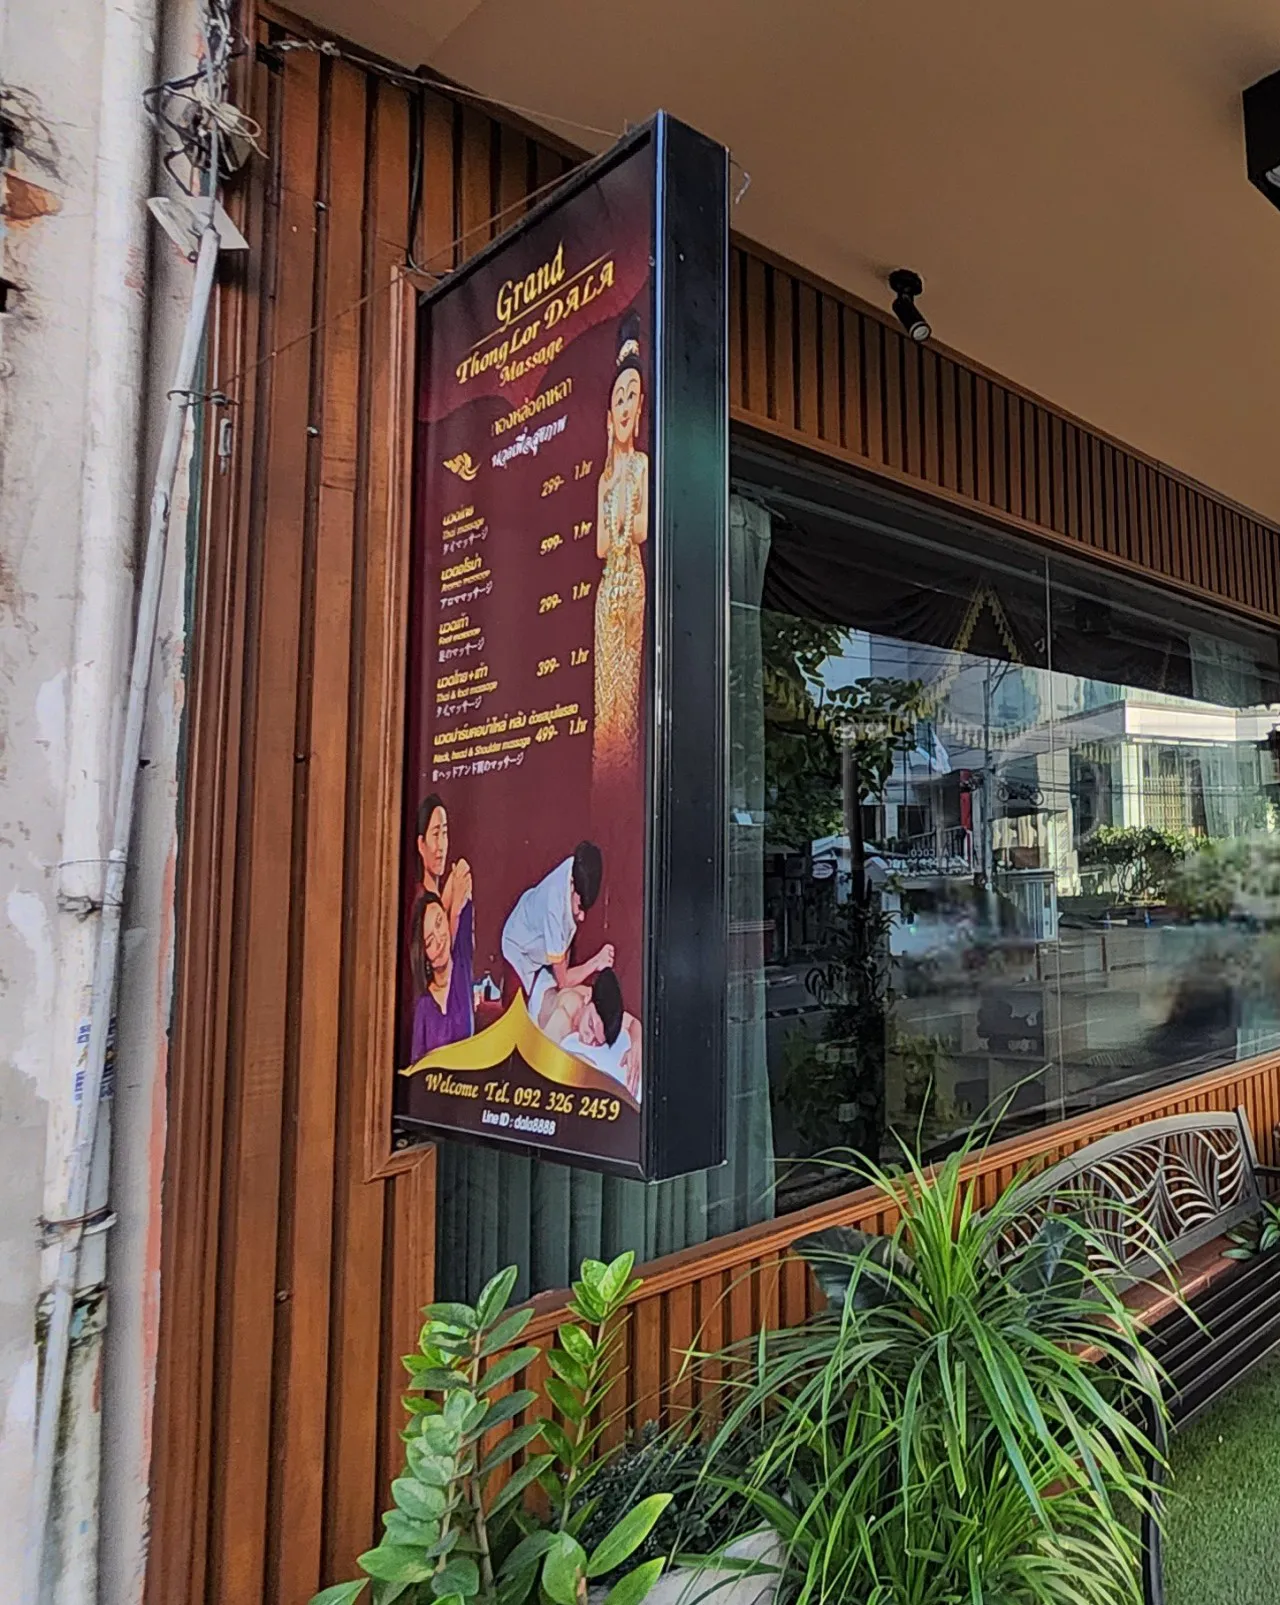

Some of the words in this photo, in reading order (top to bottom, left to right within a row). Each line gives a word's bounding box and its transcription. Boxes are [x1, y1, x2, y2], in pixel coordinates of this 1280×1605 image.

[496, 239, 566, 326] Grand
[544, 260, 616, 331] DALA
[499, 336, 564, 387] Massage
[425, 1073, 479, 1098] Welcome
[513, 1087, 541, 1109] 092
[545, 1091, 575, 1114] 326
[578, 1096, 621, 1121] 2459
